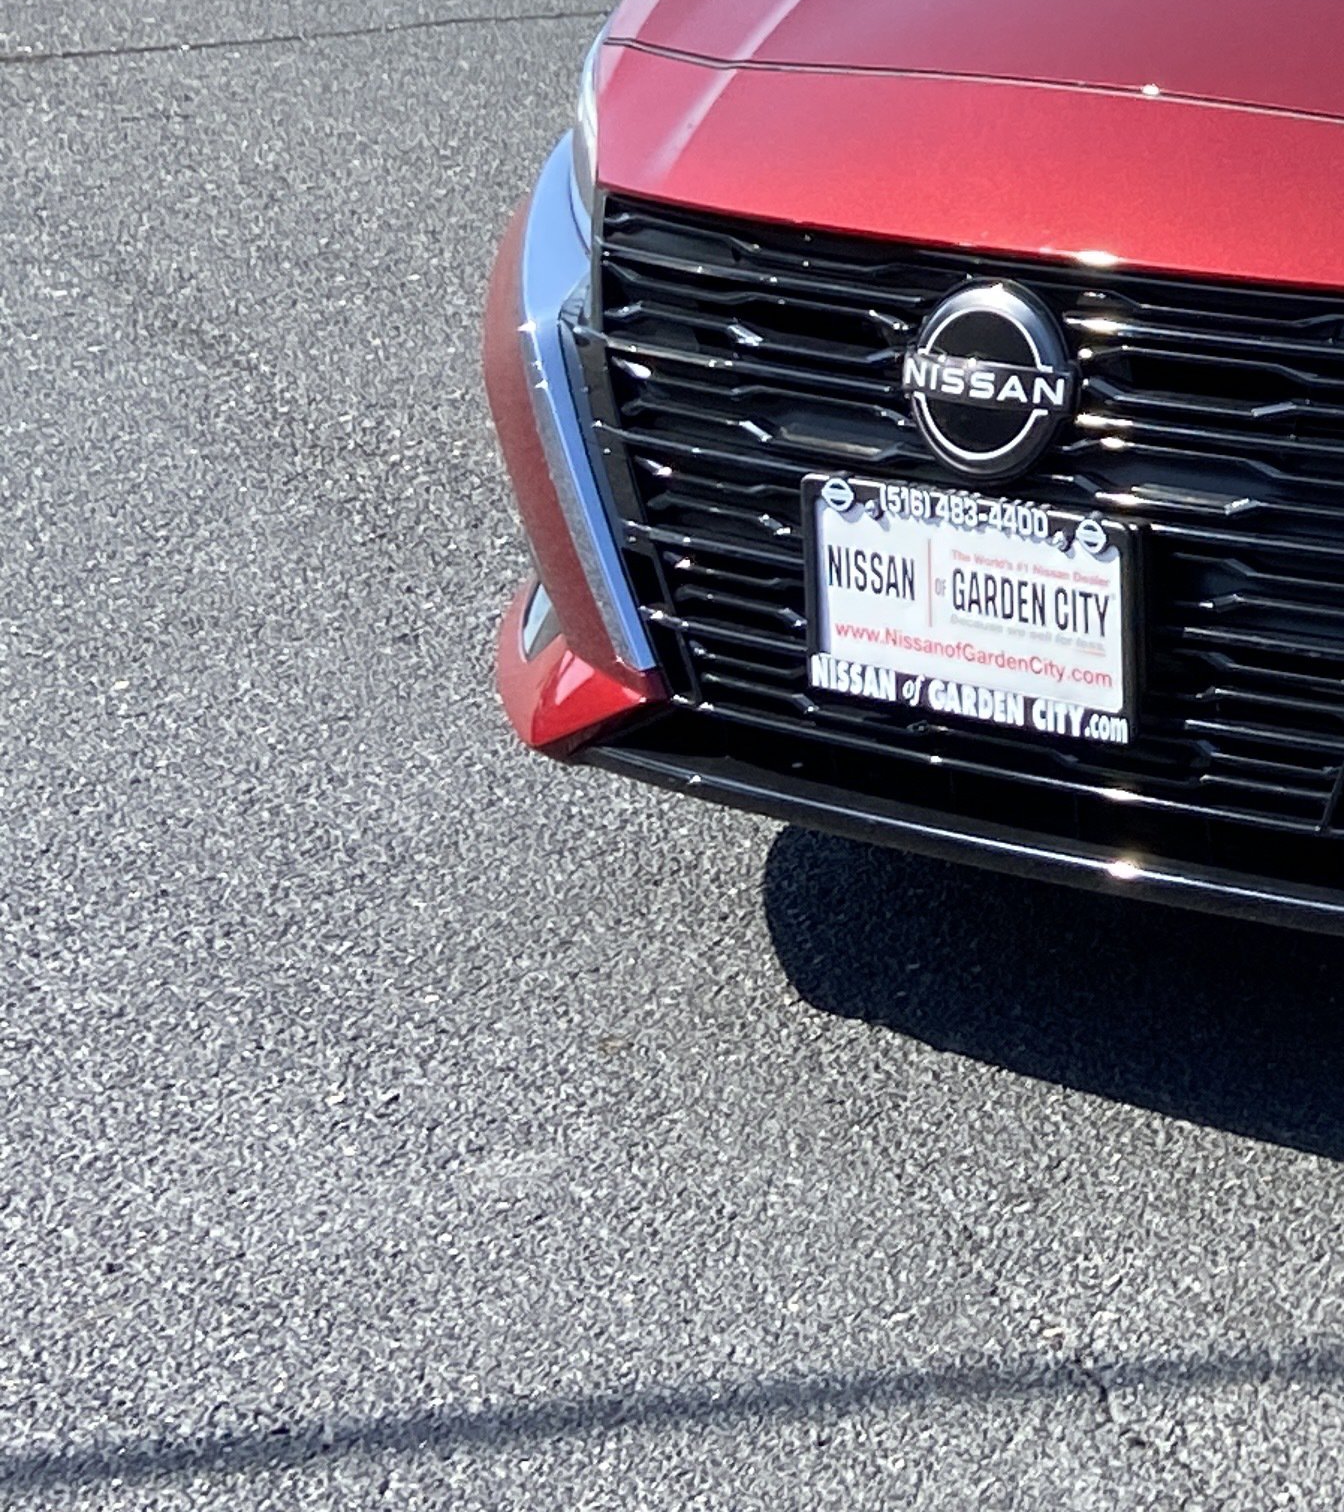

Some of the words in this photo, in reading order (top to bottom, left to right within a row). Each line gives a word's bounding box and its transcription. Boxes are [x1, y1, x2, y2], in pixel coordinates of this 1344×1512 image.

[904, 357, 1066, 406] NISSAN
[880, 485, 931, 517] (516)
[935, 492, 1049, 537] 483-4400
[827, 544, 916, 601] NISSAN
[952, 567, 1047, 627] GARDEN
[1054, 586, 1110, 637] CITY
[835, 622, 1112, 688] www.NissanofGardenCity.com
[811, 653, 897, 702] NISSAN
[902, 675, 925, 707] of
[928, 679, 1025, 727] GARDEN
